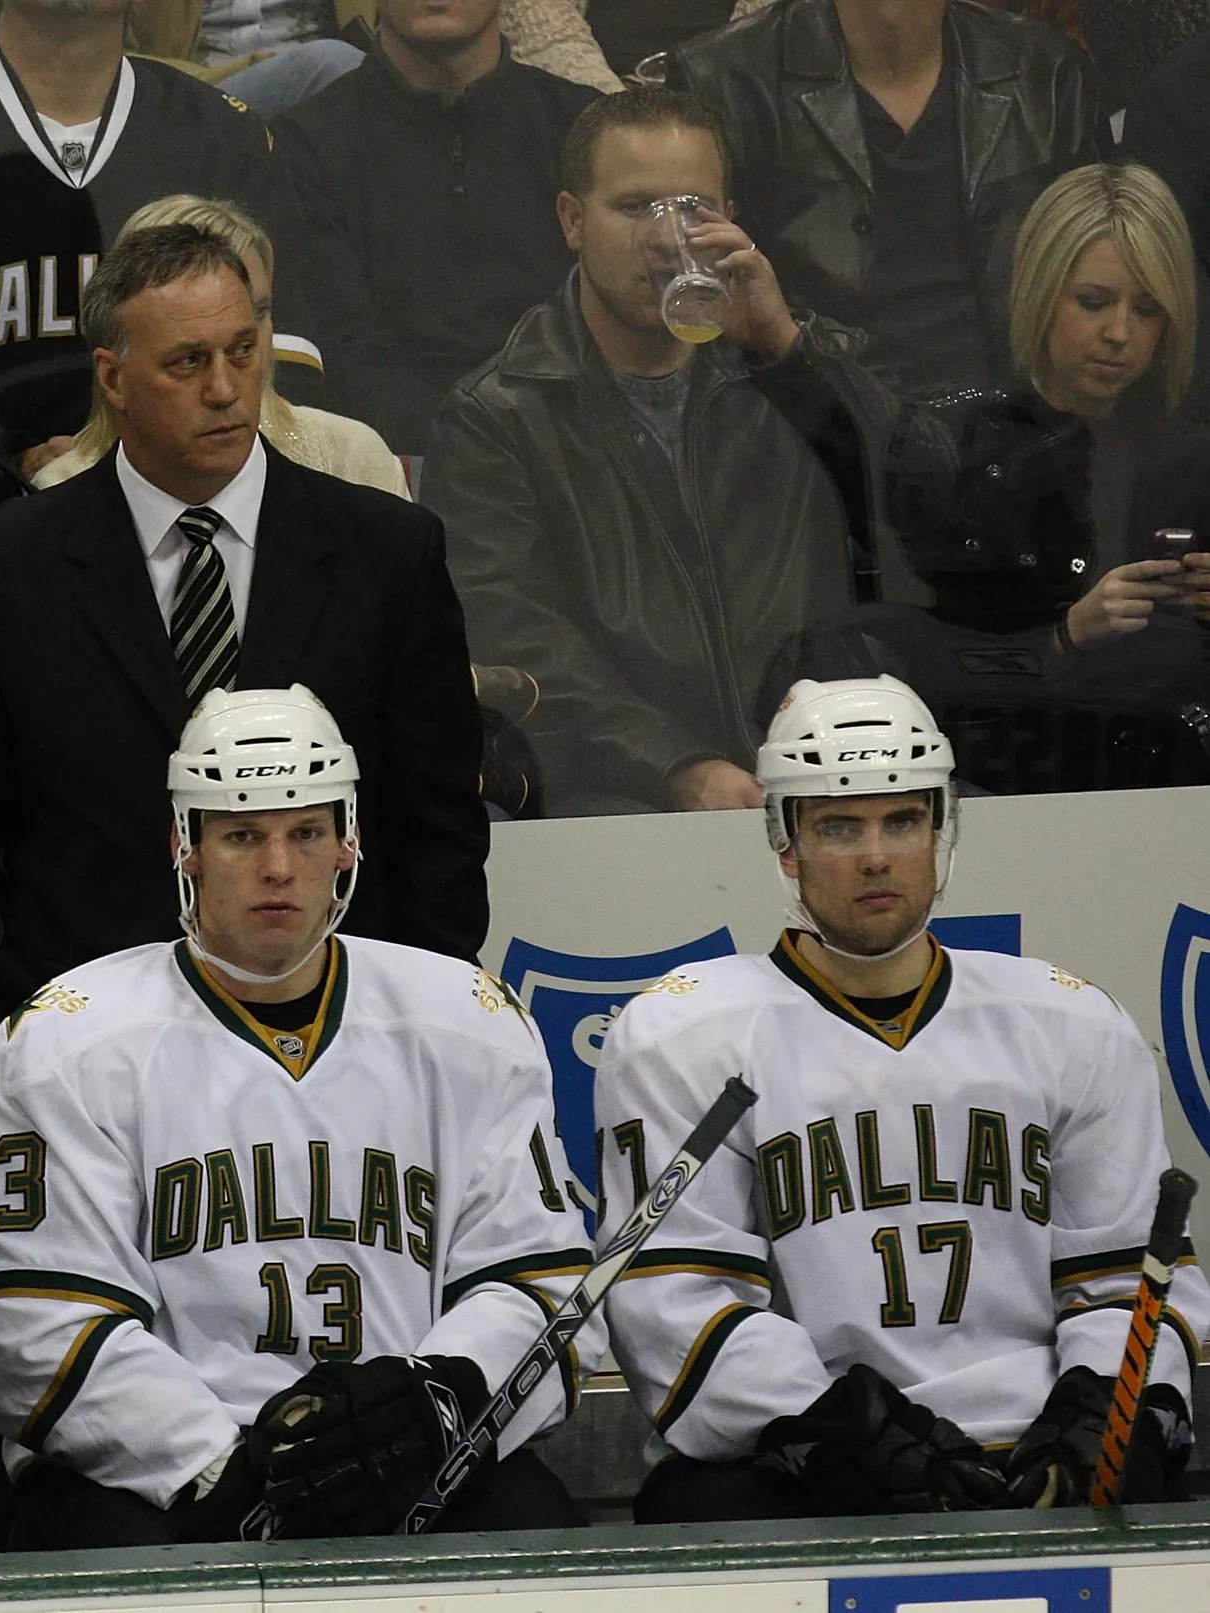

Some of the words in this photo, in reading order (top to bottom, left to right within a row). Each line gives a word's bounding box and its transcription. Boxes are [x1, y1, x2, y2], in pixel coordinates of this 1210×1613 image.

[234, 764, 298, 779] CCM
[837, 748, 900, 763] CCM
[151, 1141, 436, 1267] DALLAS
[757, 1104, 1052, 1242] DALLAS
[256, 1262, 363, 1362] 13
[873, 1219, 972, 1328] 17
